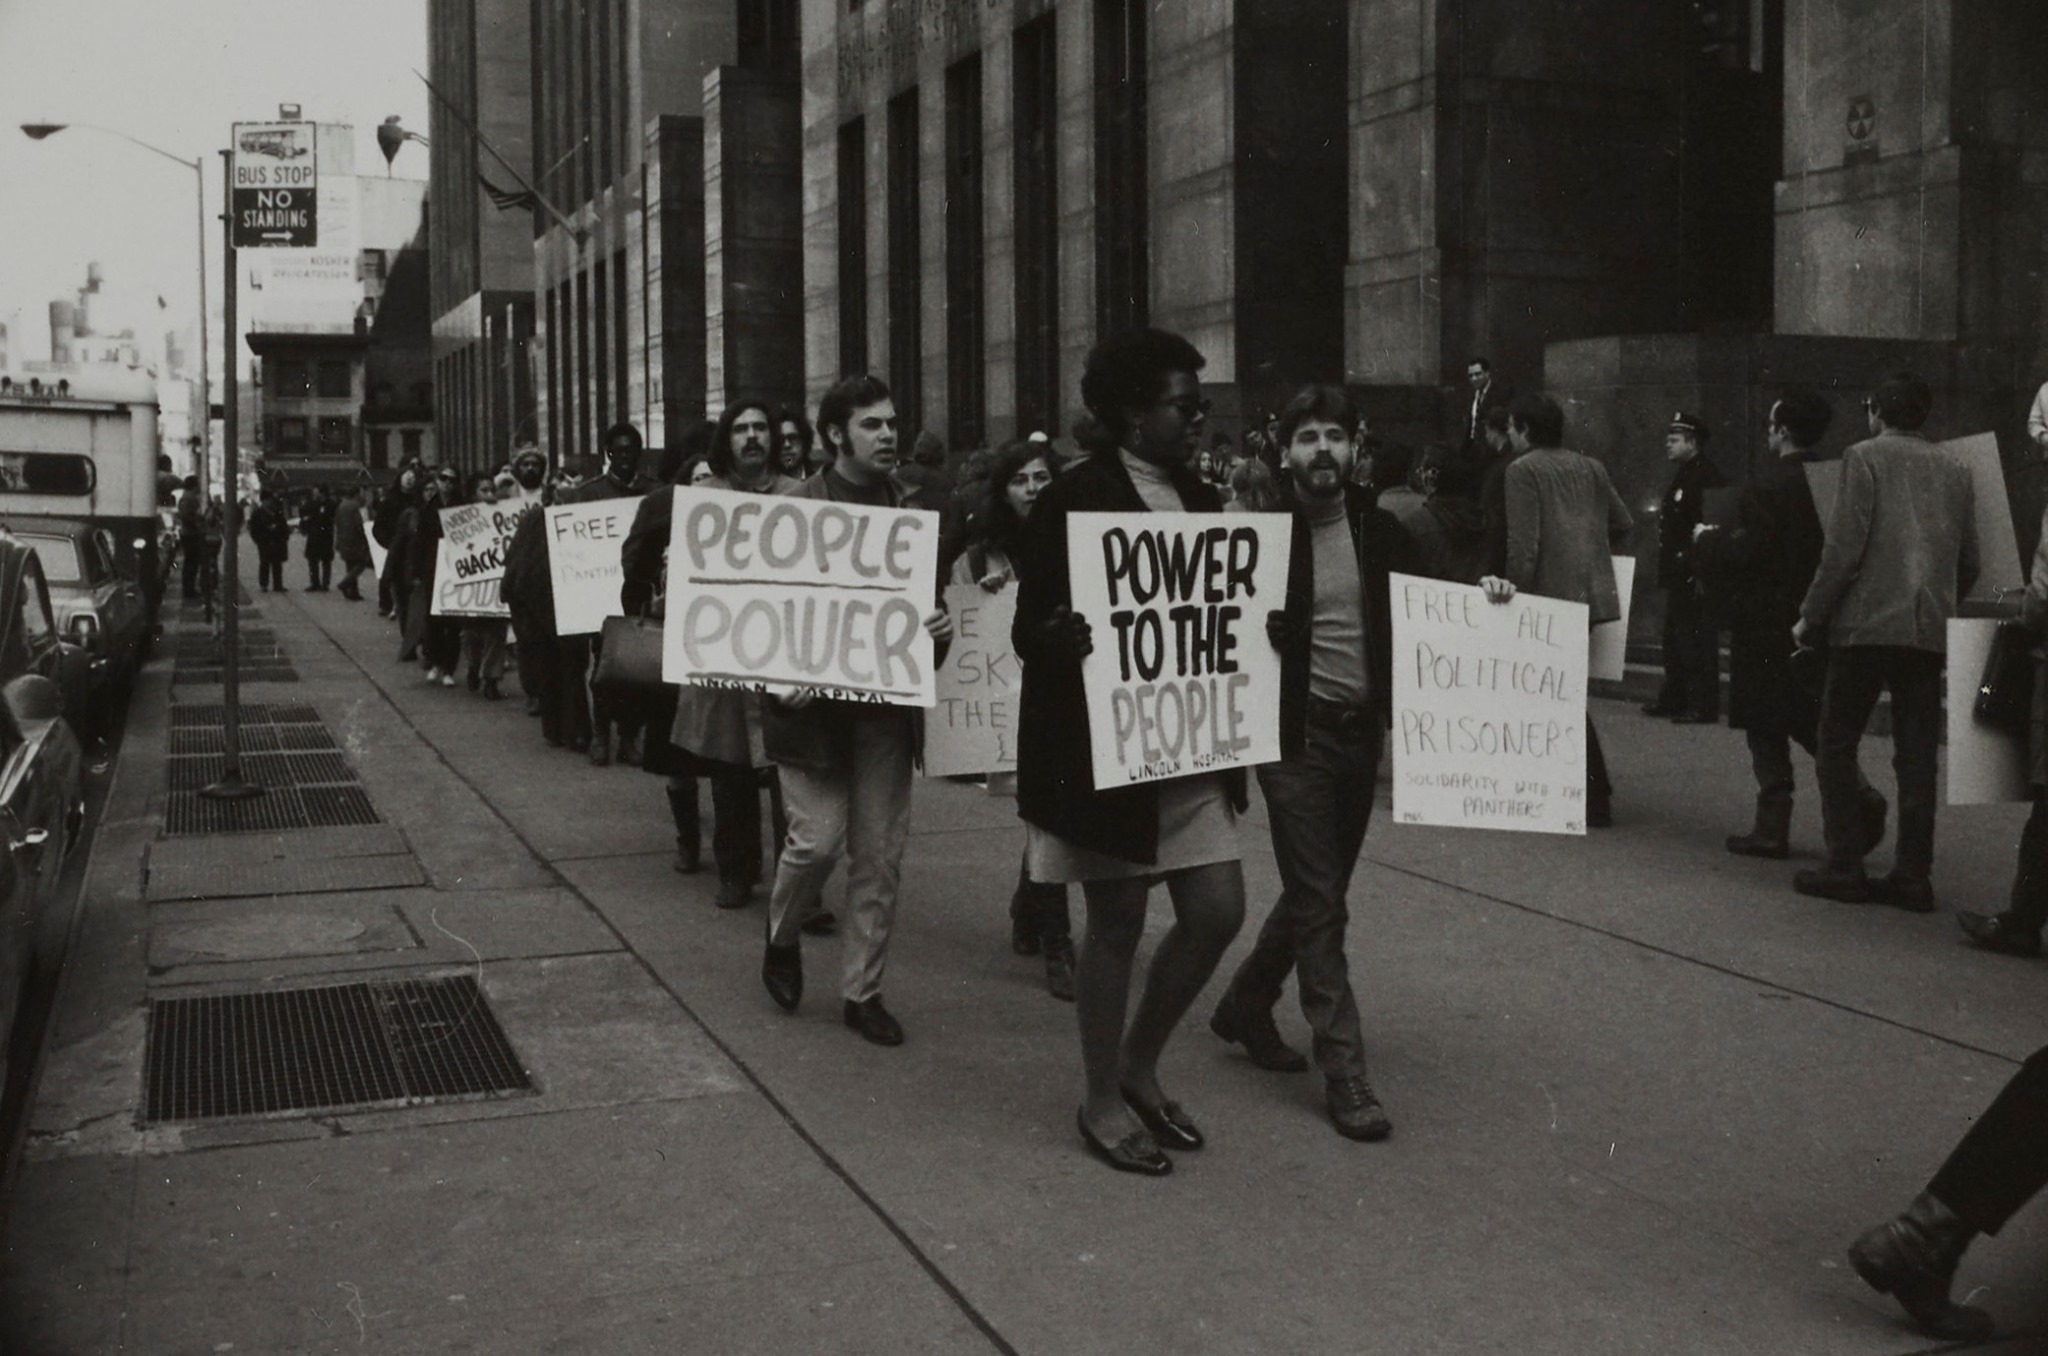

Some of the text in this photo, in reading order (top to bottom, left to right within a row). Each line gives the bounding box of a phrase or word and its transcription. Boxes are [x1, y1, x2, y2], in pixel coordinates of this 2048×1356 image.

[237, 165, 313, 184] BUS STOP
[257, 190, 292, 208] NO
[243, 209, 308, 228] STANDING
[450, 515, 490, 545] RICAN
[553, 512, 620, 542] FREE
[686, 501, 924, 580] PEOPLE
[455, 547, 504, 578] BLACK
[1102, 527, 1259, 607] POWER
[440, 579, 505, 609] POW
[1404, 583, 1561, 648] FREE ALL
[683, 595, 921, 687] POWER
[1110, 605, 1242, 682] TO THE
[1416, 641, 1569, 702] POLITICAL
[801, 685, 893, 704] OSPITAL
[940, 698, 1007, 728] THE
[1111, 673, 1250, 766] PEOPLE
[1400, 709, 1579, 765] PRISONERS
[1129, 751, 1240, 781] LINCOLN HOSPITAL
[1405, 772, 1584, 801] SOLIDARITY WITH THE
[1463, 796, 1545, 818] PANTHERS
